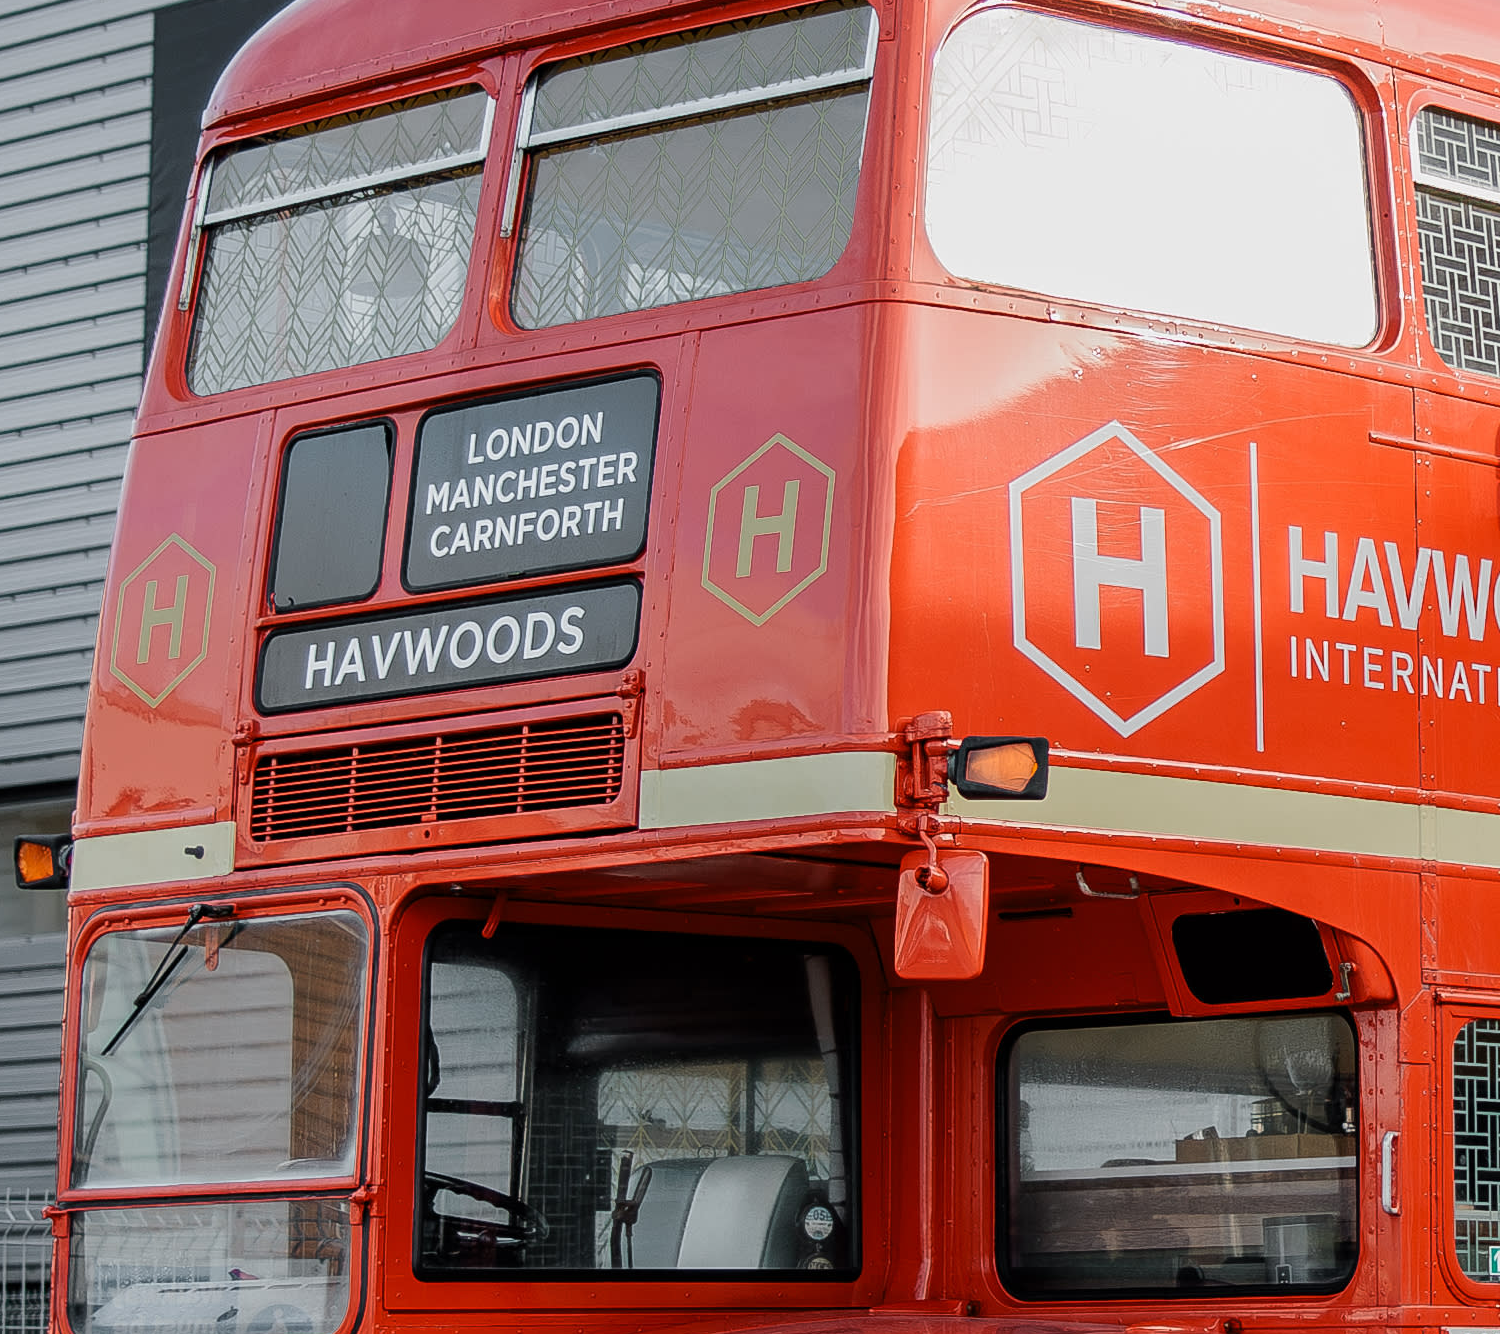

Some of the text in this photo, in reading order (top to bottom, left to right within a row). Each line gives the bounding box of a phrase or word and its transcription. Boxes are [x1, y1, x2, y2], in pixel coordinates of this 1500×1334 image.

[467, 412, 604, 464] LONDON
[425, 451, 638, 515] MANCHESTER
[430, 499, 626, 559] CARNFORTH
[735, 480, 800, 578] H
[138, 573, 189, 664] H
[1071, 497, 1169, 658] H
[304, 606, 587, 690] HAVWOODS
